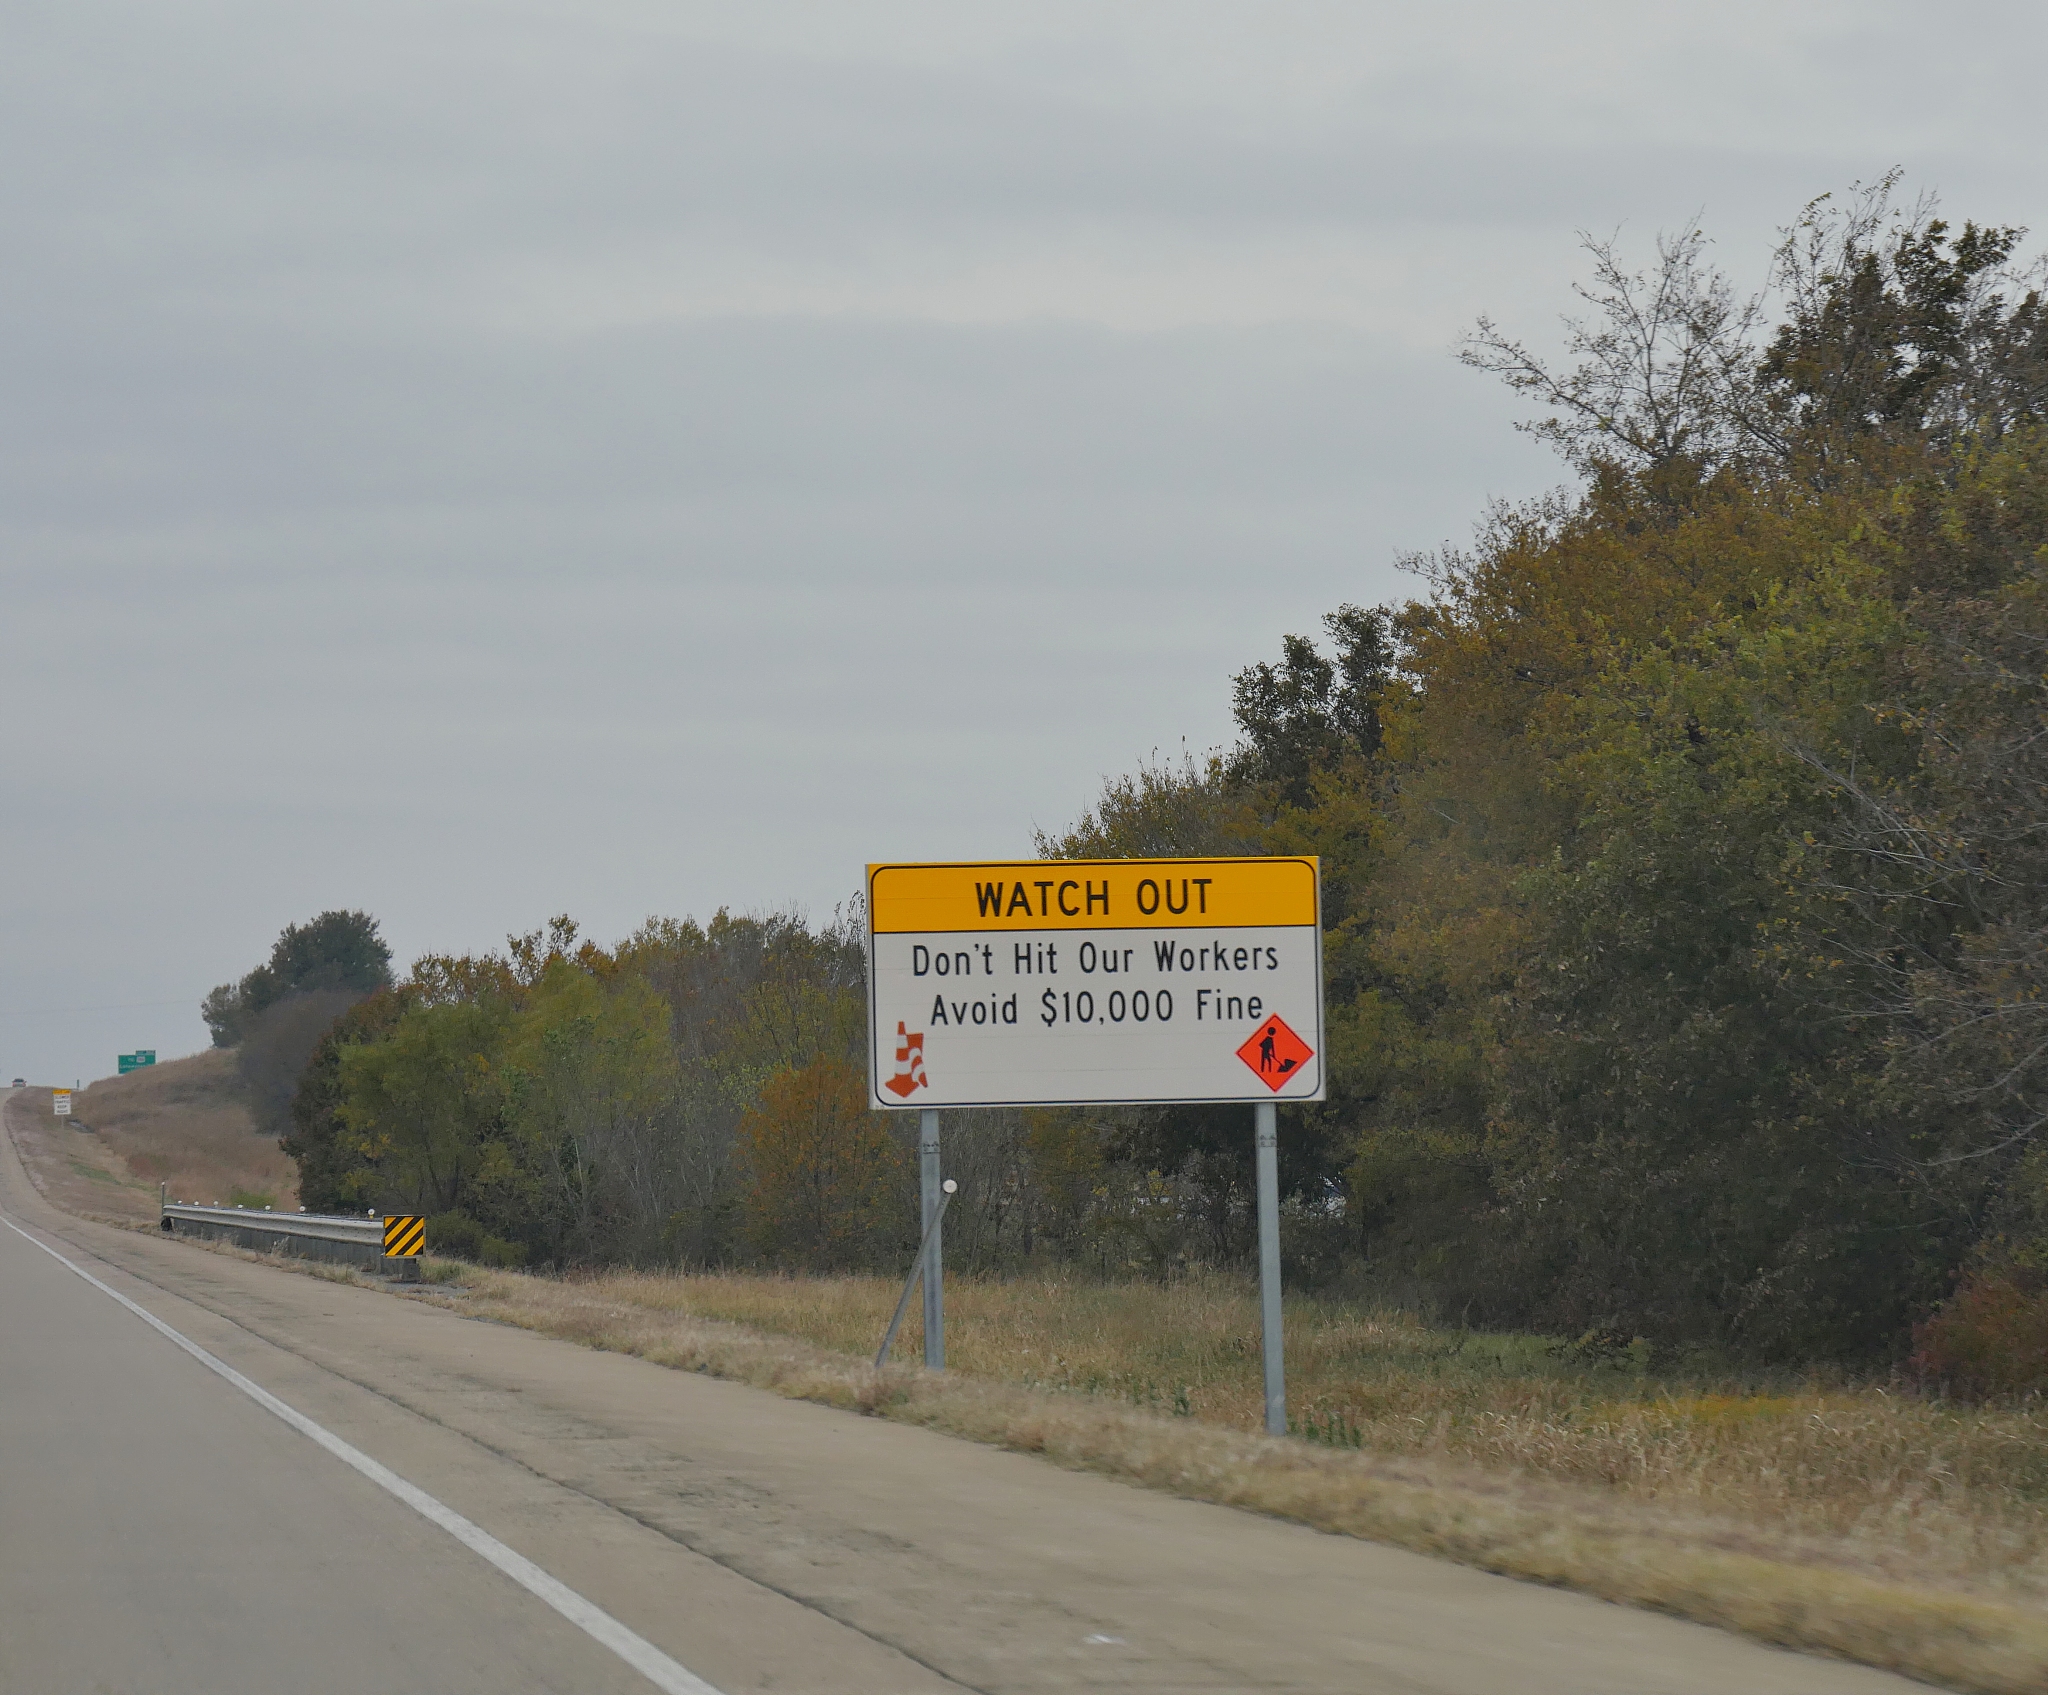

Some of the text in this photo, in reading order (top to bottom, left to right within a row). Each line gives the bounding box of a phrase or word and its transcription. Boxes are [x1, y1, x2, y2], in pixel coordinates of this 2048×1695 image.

[974, 878, 1213, 918] WATCH OUT
[912, 940, 1279, 977] Don't Hit Our Workers
[930, 987, 1263, 1027] Avoid $10,000 Fine
